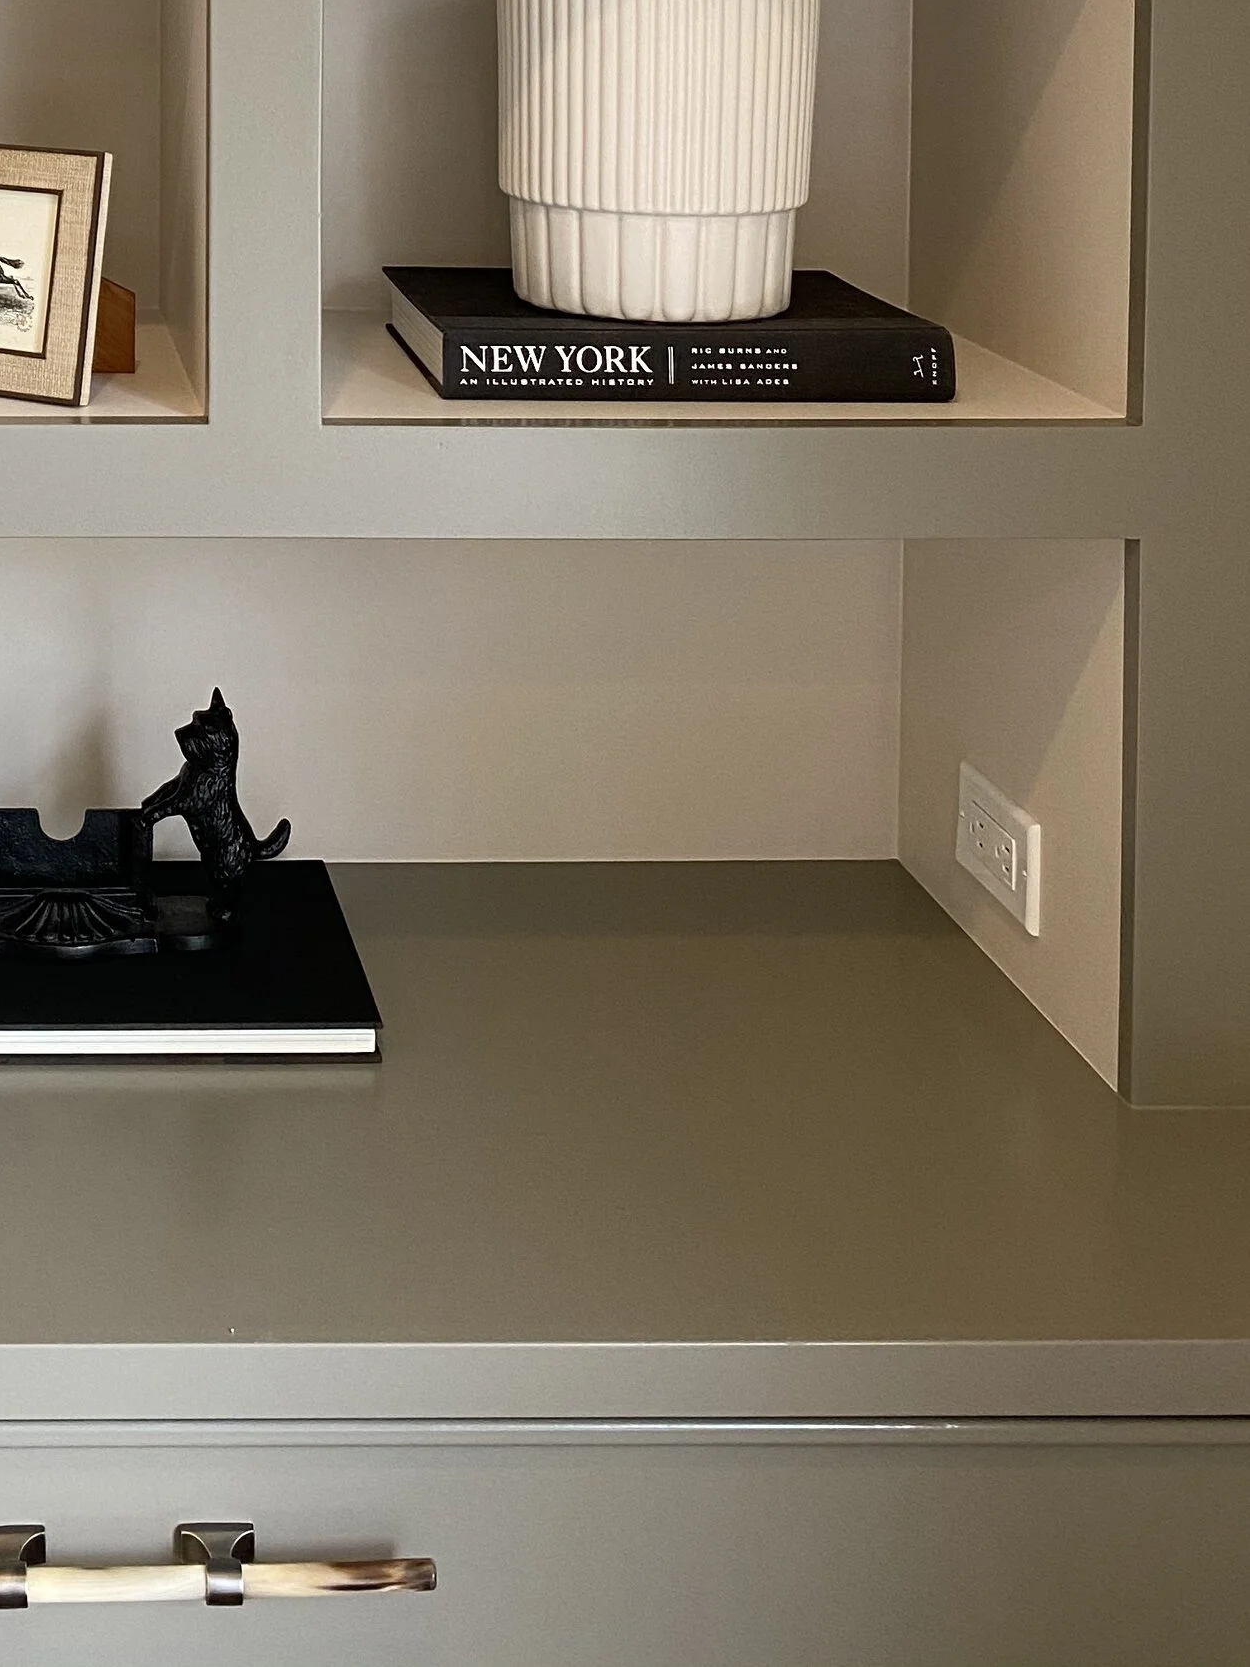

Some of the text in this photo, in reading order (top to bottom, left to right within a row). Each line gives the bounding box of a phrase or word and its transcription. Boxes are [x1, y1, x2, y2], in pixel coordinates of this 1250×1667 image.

[718, 347, 762, 355] BURNS
[459, 345, 654, 373] NEW YORK
[486, 378, 584, 386] ILLUSTRATED
[592, 378, 654, 386] HISTORY
